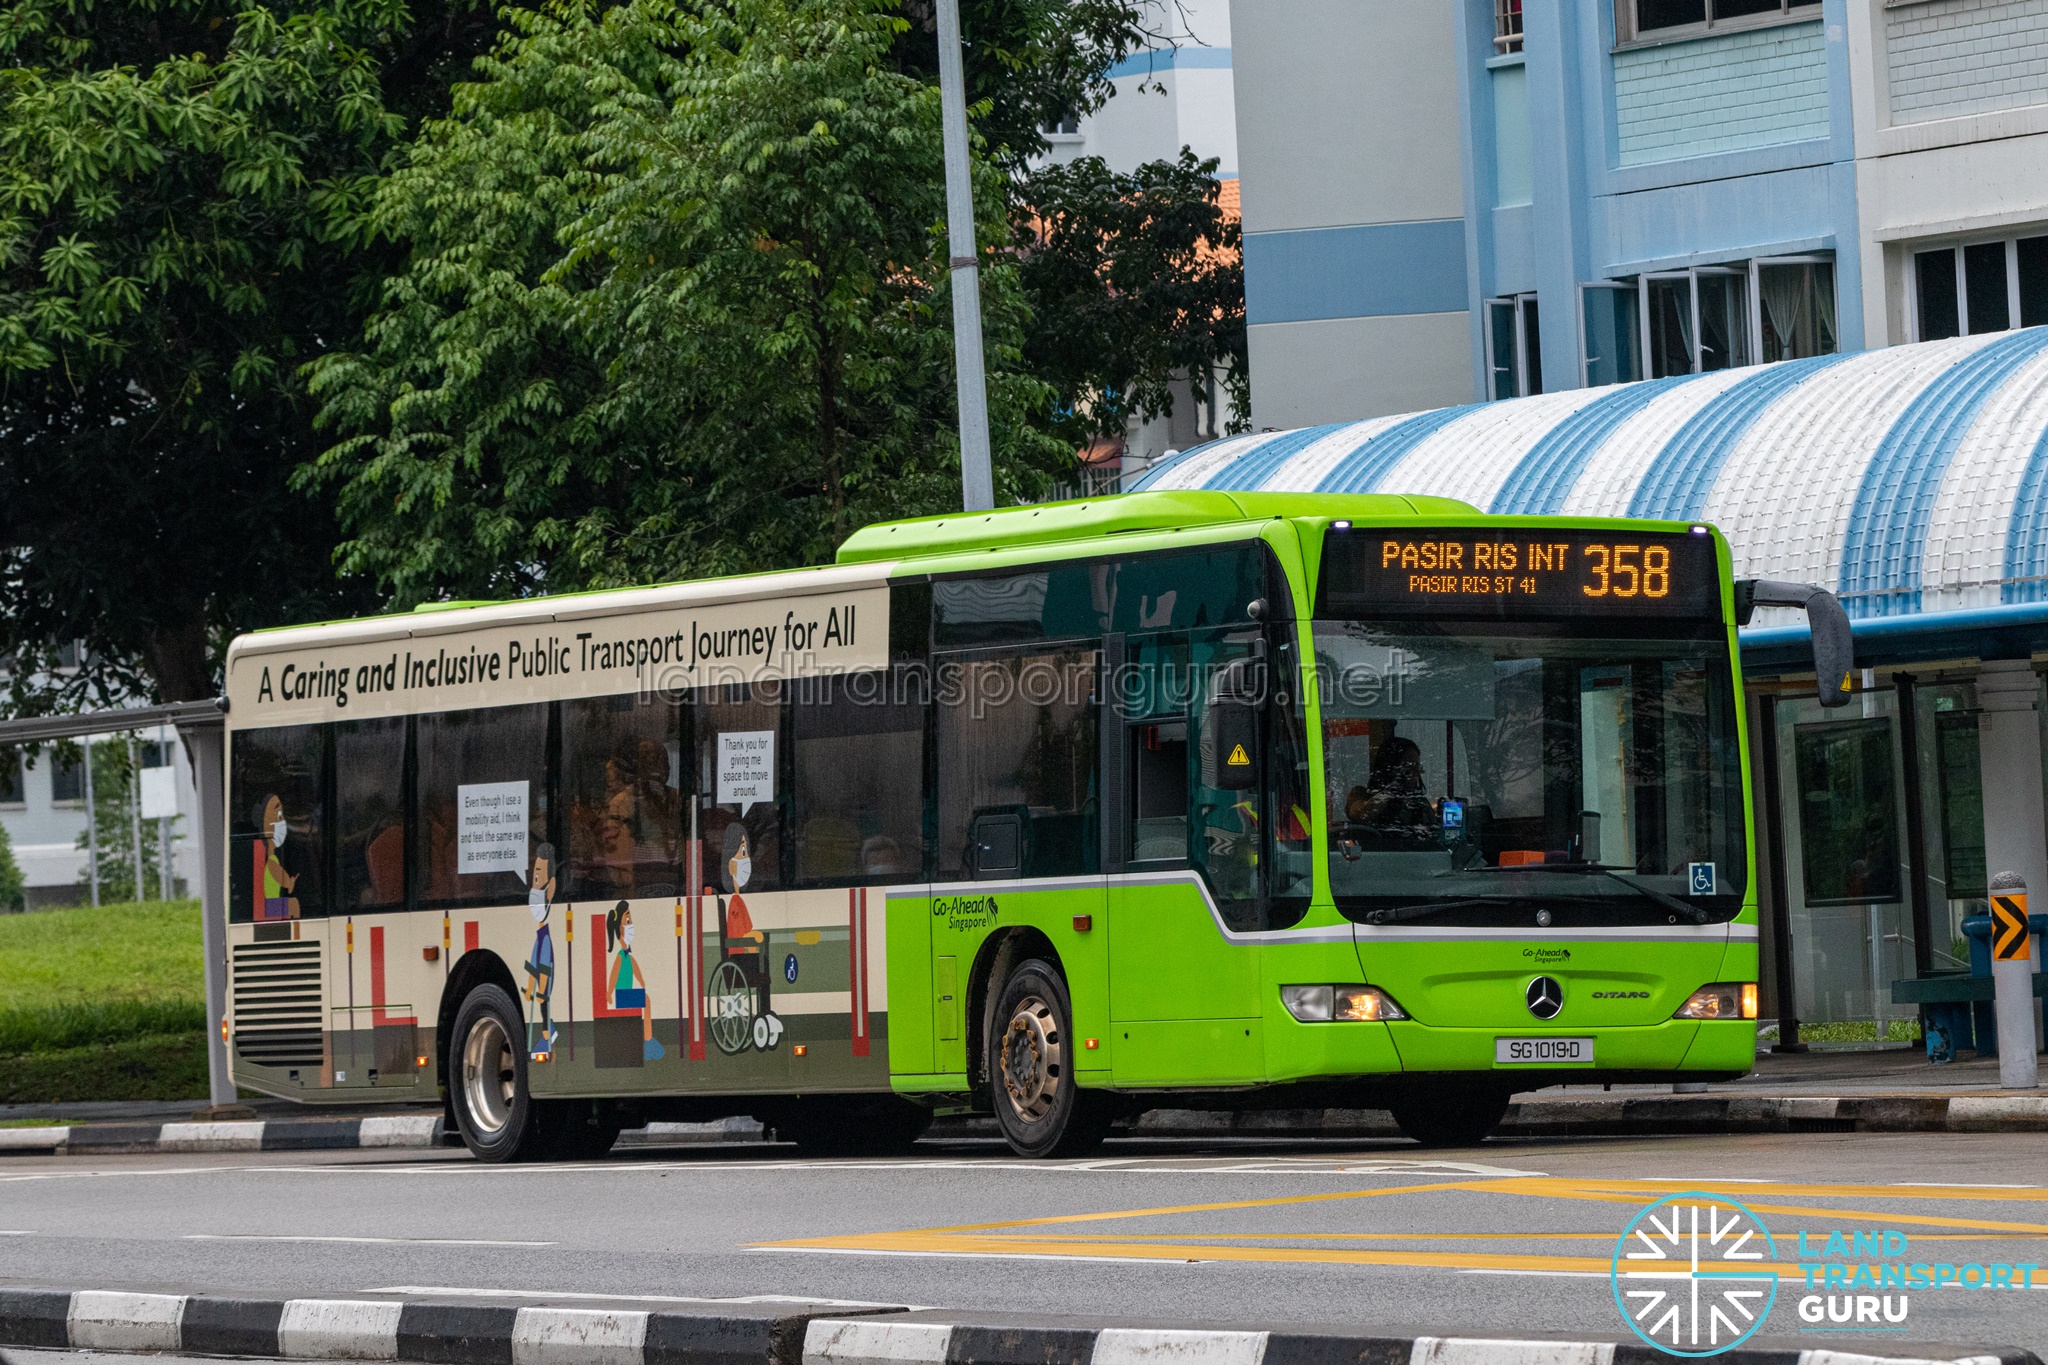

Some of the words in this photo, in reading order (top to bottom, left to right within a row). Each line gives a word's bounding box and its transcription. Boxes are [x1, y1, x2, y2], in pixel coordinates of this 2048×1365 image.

[1382, 541, 1463, 571] PASIR
[1475, 542, 1517, 571] RIS
[1529, 543, 1569, 571] INT
[1583, 544, 1670, 597] 358
[1409, 575, 1457, 593] PASIR
[1462, 576, 1489, 593] RIS
[1495, 576, 1514, 594] ST
[1520, 577, 1536, 594] 41
[257, 666, 274, 704] A
[281, 661, 350, 708] Caring
[356, 653, 397, 695] and
[404, 645, 500, 690] Inclusive
[508, 636, 571, 679] Public
[576, 629, 683, 678] Transport
[688, 620, 777, 673] Journey
[784, 611, 818, 651] for
[823, 605, 856, 649] All
[724, 738, 744, 750] Thank
[745, 740, 757, 752] you
[758, 737, 767, 749] for
[730, 753, 750, 769] giving
[750, 756, 762, 765] me
[723, 772, 742, 784] space
[743, 770, 750, 781] to
[750, 771, 768, 780] move
[733, 784, 758, 797] around.
[465, 796, 479, 808] Even
[480, 794, 500, 809] though
[506, 796, 517, 806] use
[465, 813, 489, 827] mobility
[505, 811, 521, 823] think
[460, 831, 472, 844] and
[473, 831, 484, 843] feel
[485, 830, 495, 842] the
[496, 831, 512, 842] same
[513, 831, 526, 843] way
[467, 851, 475, 861] as
[475, 849, 502, 863] everyone
[503, 847, 518, 859] else.
[933, 895, 985, 916] Go-Ahead
[948, 916, 987, 932] Singapore
[1522, 948, 1561, 957] Go-Ahead
[1510, 1041, 1580, 1059] SG1019D
